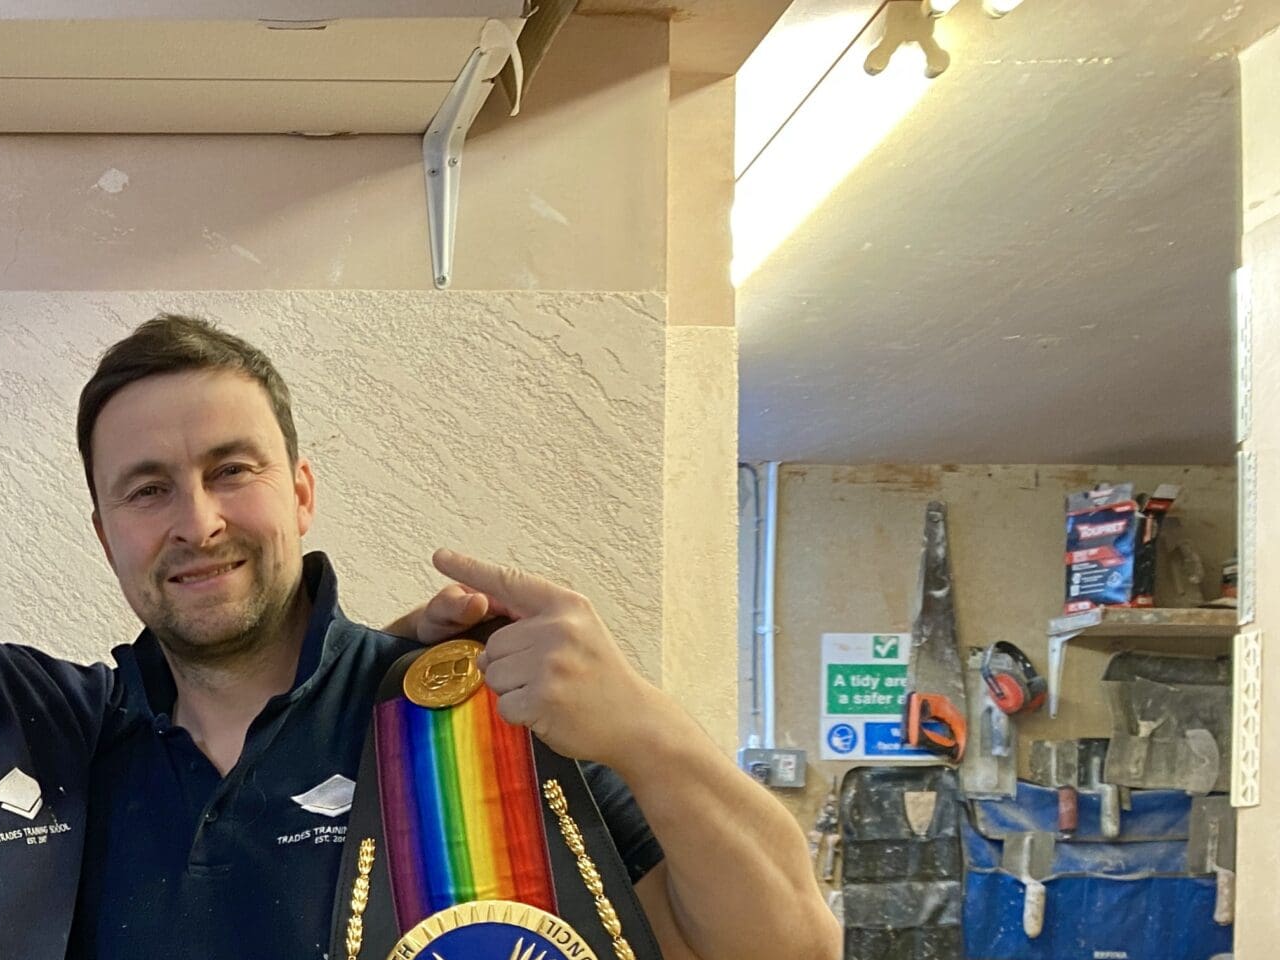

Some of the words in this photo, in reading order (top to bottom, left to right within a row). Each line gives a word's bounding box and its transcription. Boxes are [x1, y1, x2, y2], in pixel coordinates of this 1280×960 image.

[833, 674, 846, 687] A
[850, 674, 880, 689] tidy
[838, 694, 849, 705] a
[853, 691, 893, 705] safer
[277, 830, 311, 844] TRADES
